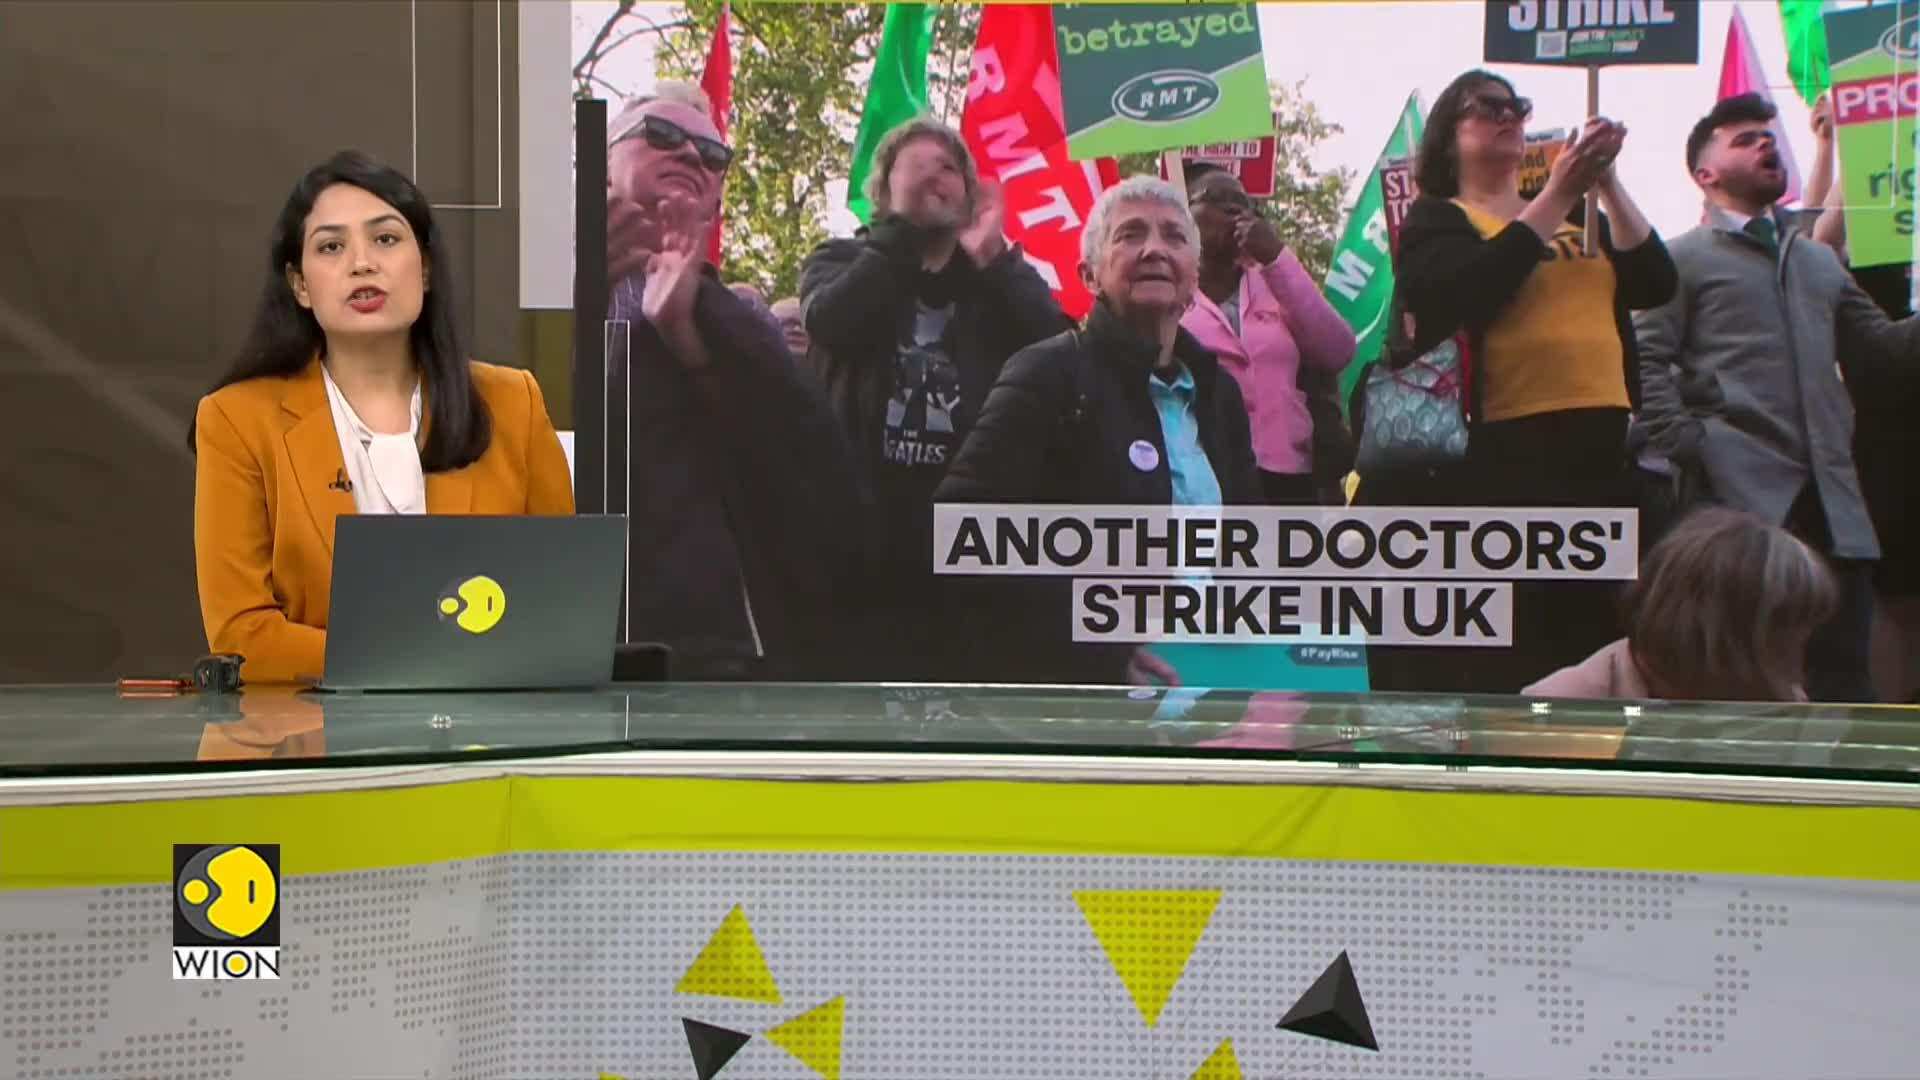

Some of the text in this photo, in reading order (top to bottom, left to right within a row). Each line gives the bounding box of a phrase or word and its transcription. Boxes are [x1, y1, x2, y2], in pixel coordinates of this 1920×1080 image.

[1058, 2, 1255, 54] betrayed
[1139, 85, 1199, 109] RMT
[945, 516, 1623, 571] ANOTHER DOCTORS'
[1082, 584, 1498, 637] STRIKE IN UK
